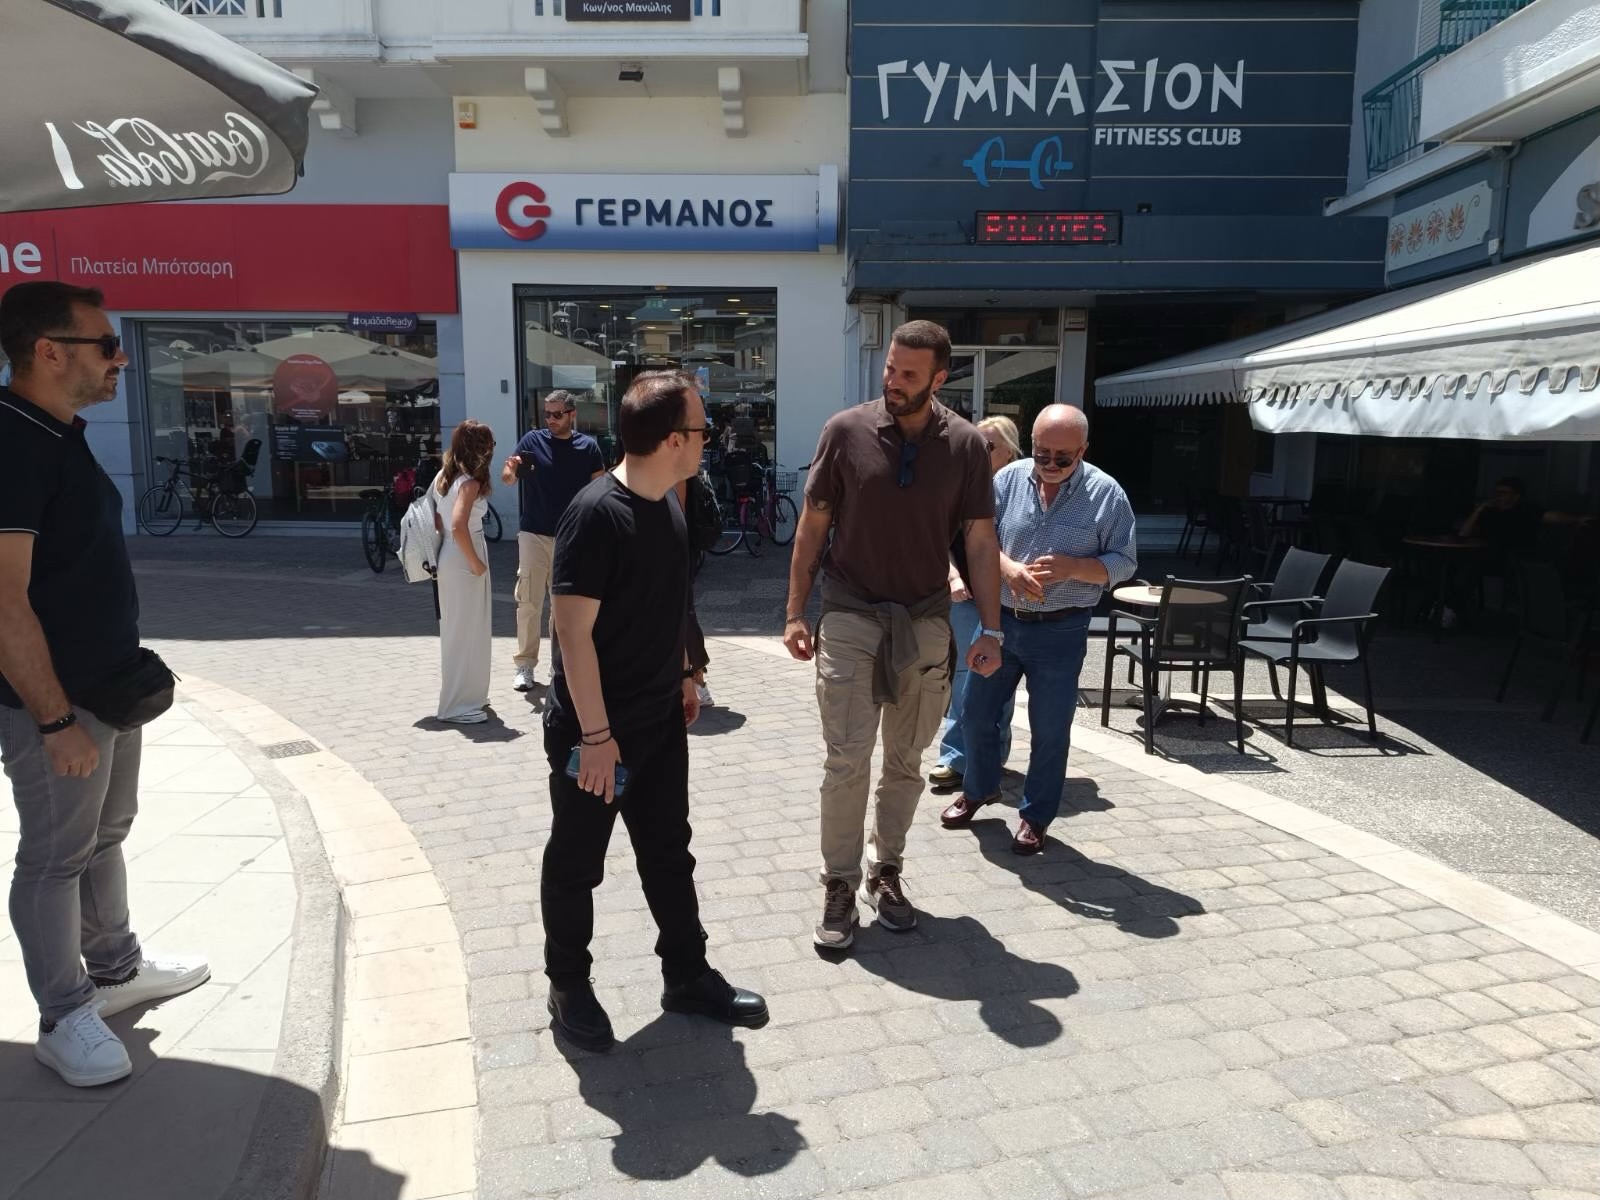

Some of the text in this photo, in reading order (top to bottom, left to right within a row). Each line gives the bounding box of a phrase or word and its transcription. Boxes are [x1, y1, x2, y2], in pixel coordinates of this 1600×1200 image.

[583, 2, 672, 14] Κων/νος Μανώλης
[877, 57, 1245, 124] ΓΥΜΝΑΣΙΟΝ
[1094, 127, 1242, 146] FITNESS CLUB
[575, 198, 775, 228] ΓΕΡΜΑΝΟΣ
[71, 257, 233, 278] Πλατεία Μπότσαρη
